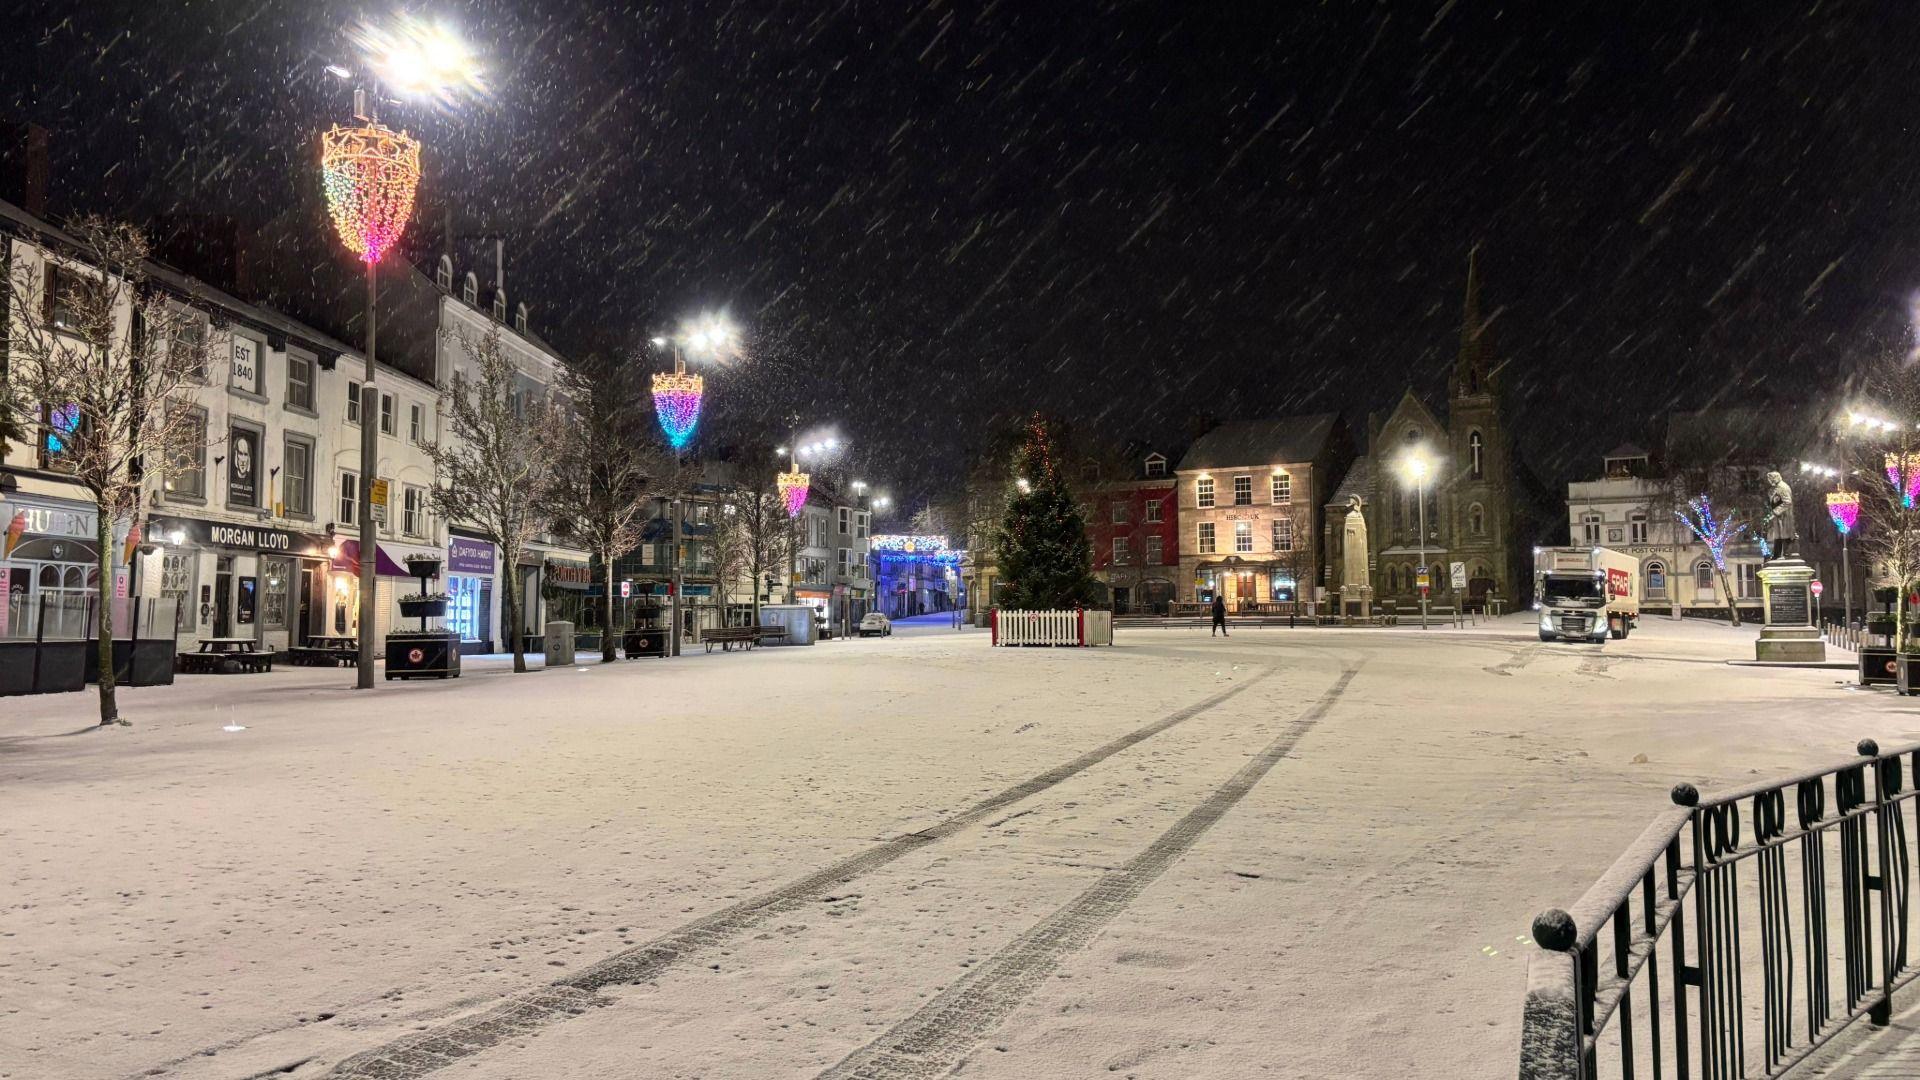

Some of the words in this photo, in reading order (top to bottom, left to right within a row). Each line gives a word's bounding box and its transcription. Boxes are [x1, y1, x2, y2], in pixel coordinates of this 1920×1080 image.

[235, 345, 250, 362] EST
[233, 362, 253, 381] 1840
[211, 526, 255, 546] MORGAN
[259, 532, 288, 549] LLOYD
[1649, 546, 1673, 554] OFFICE
[1612, 574, 1628, 592] SPAR
